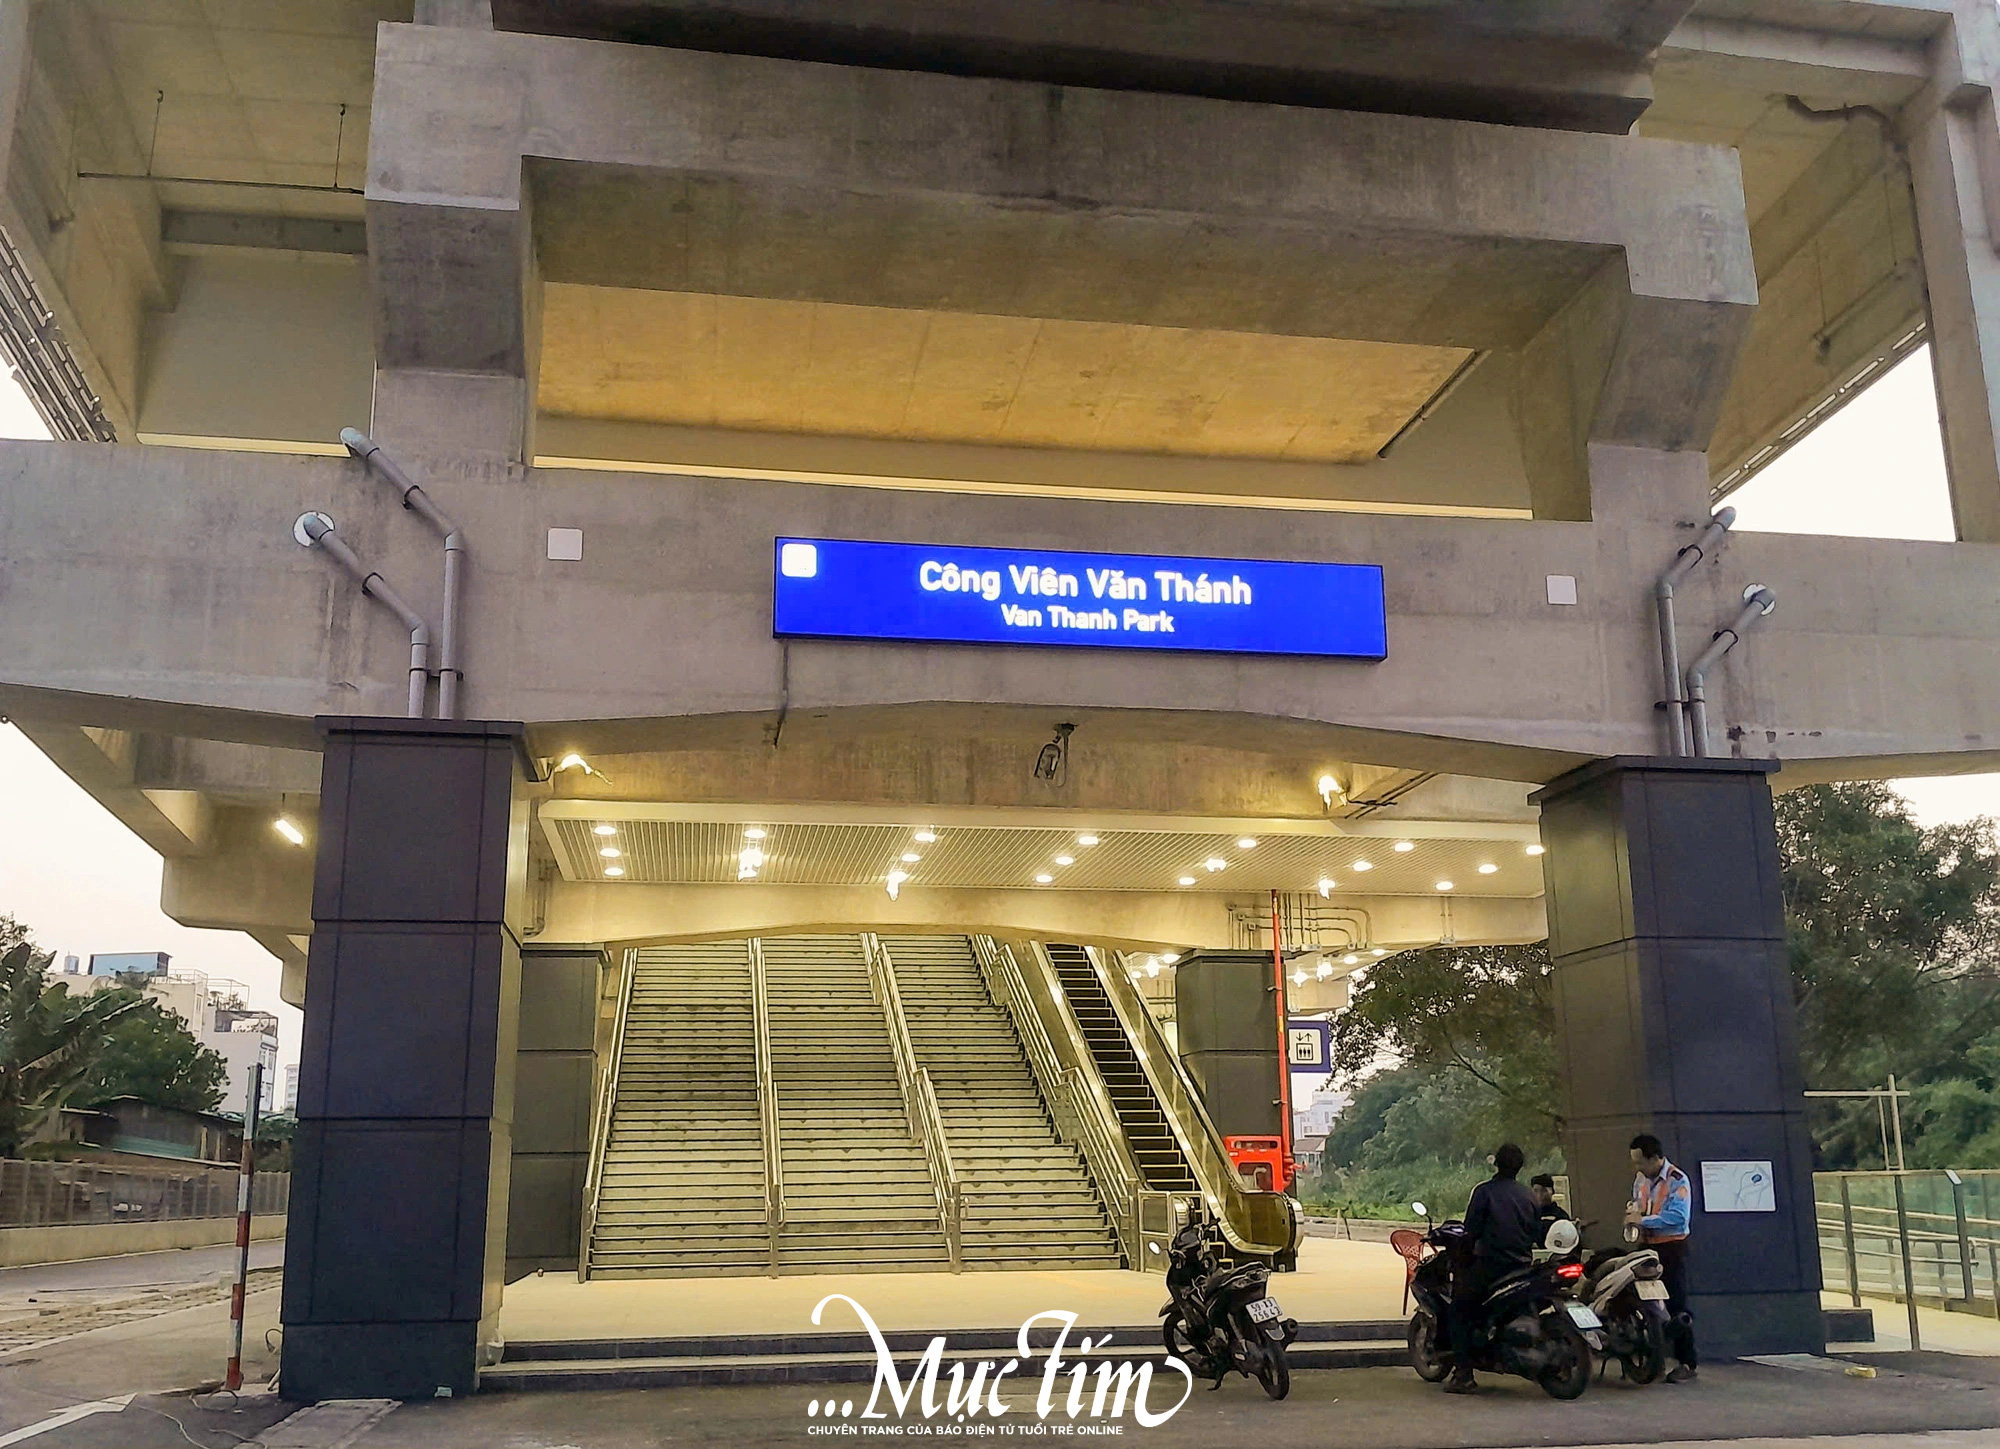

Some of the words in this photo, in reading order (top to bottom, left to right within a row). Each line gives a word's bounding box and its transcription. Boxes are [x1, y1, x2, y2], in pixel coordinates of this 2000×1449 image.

[919, 560, 1001, 602] Công
[1007, 563, 1079, 598] Viên
[1085, 567, 1148, 602] Văn
[1153, 570, 1252, 605] Thánh
[1000, 603, 1043, 628] Van
[1046, 605, 1118, 631] Thanh
[1122, 607, 1176, 633] Park
